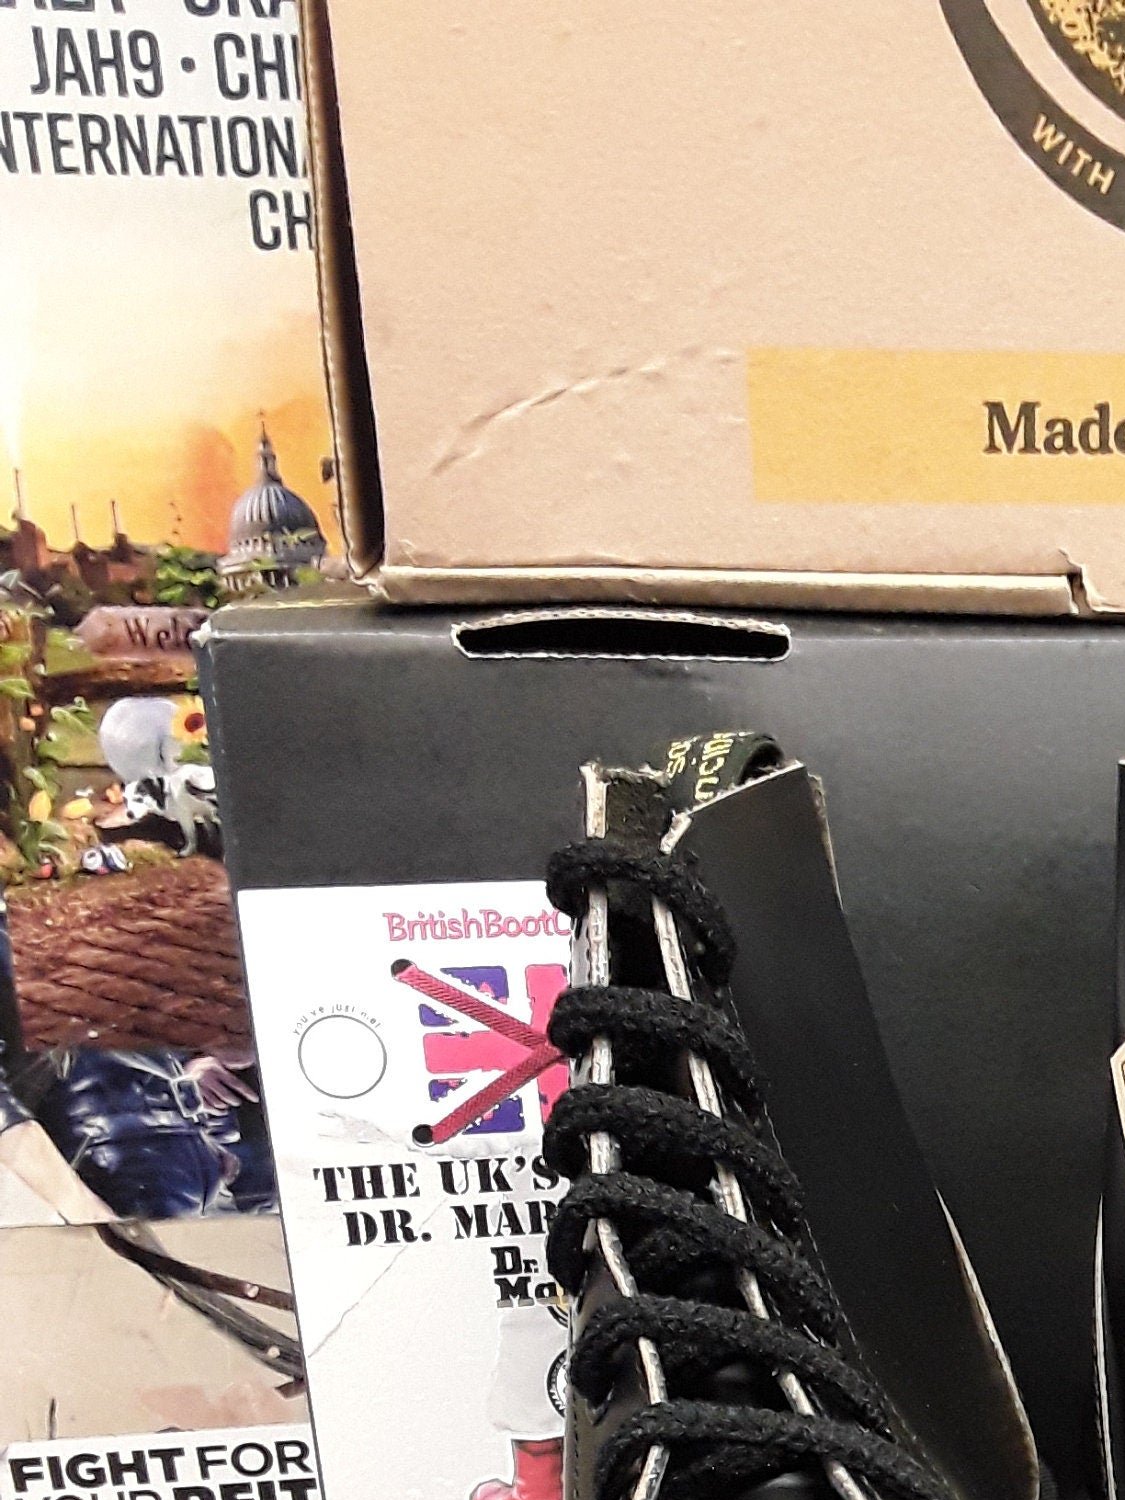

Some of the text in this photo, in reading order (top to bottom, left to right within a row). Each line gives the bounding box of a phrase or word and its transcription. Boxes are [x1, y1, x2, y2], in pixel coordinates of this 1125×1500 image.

[30, 25, 164, 98] JAH9
[0, 111, 308, 178] NTERNATION
[1031, 112, 1115, 195] WITH
[313, 1154, 561, 1203] THE UK'S
[344, 1210, 432, 1248] DR.
[491, 1245, 539, 1276] Dr.
[8, 1439, 314, 1493] FIGHT FOR
